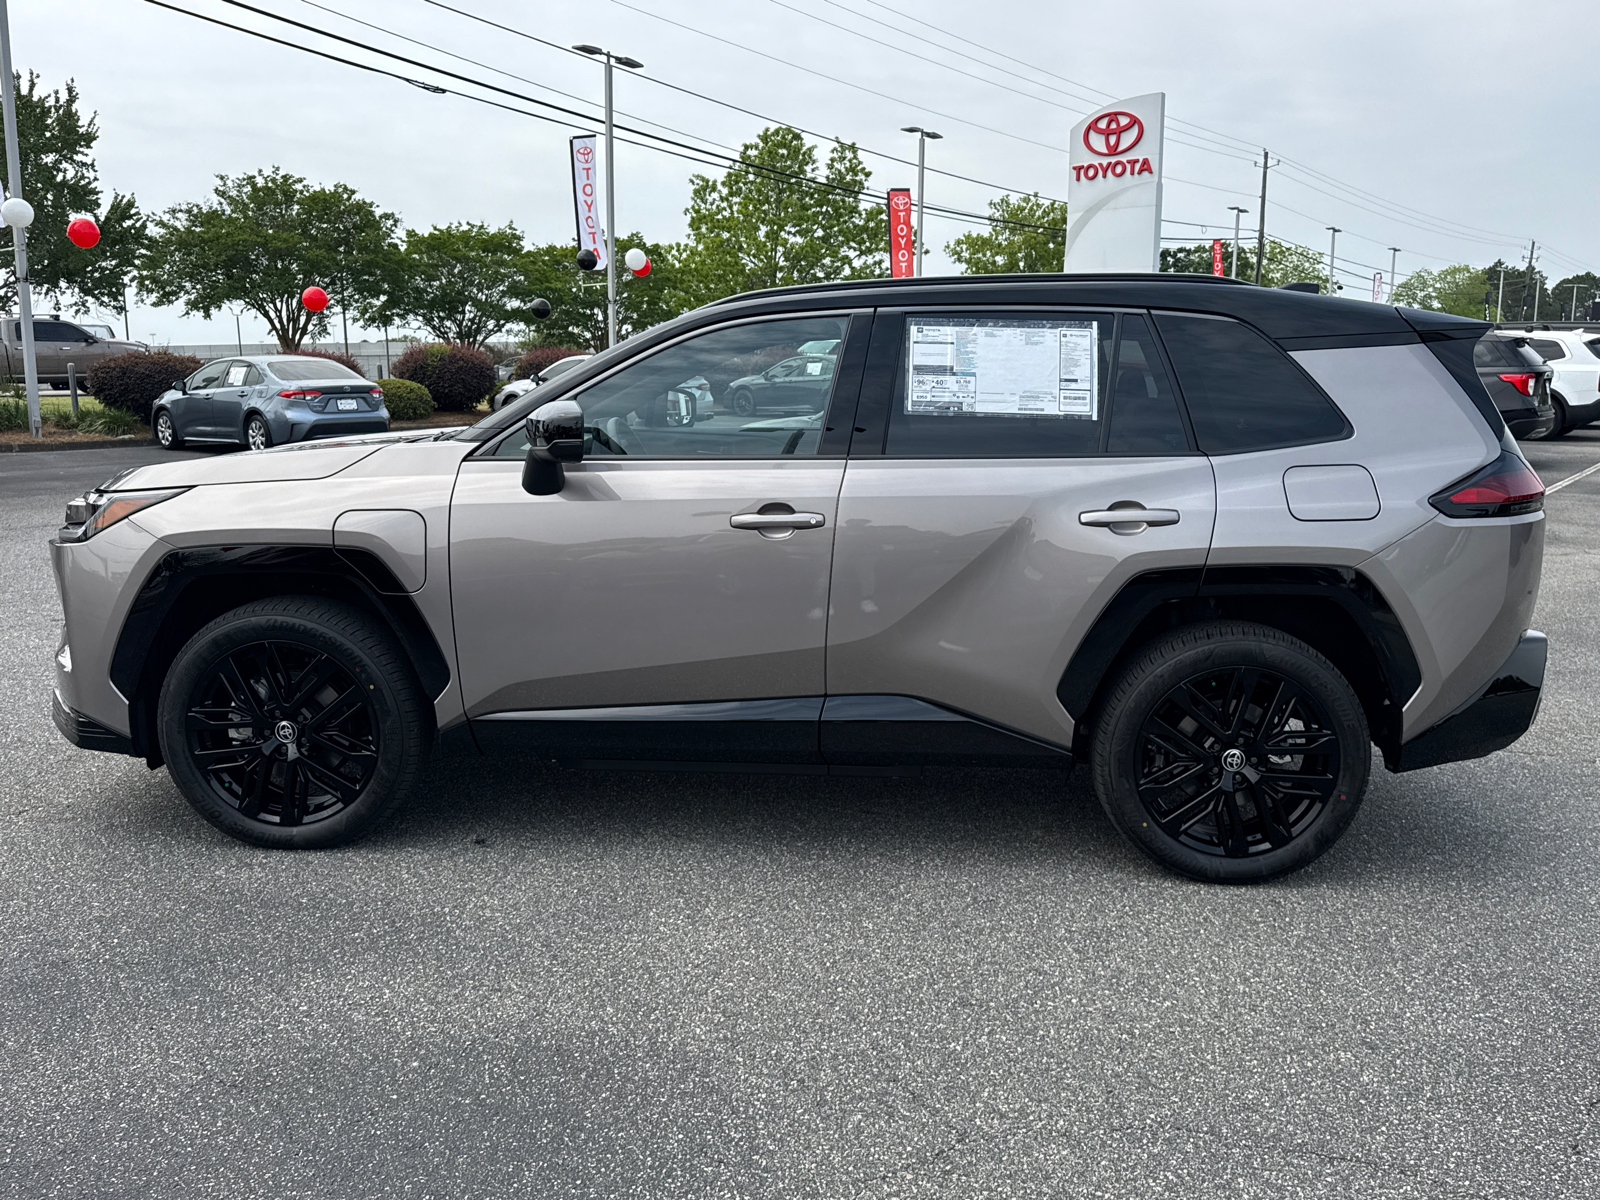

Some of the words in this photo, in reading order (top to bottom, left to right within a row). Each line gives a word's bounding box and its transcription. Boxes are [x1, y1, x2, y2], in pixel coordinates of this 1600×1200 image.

[1072, 157, 1153, 182] TOYOTA
[582, 167, 602, 260] TOYOTA
[897, 212, 908, 278] TOYOT
